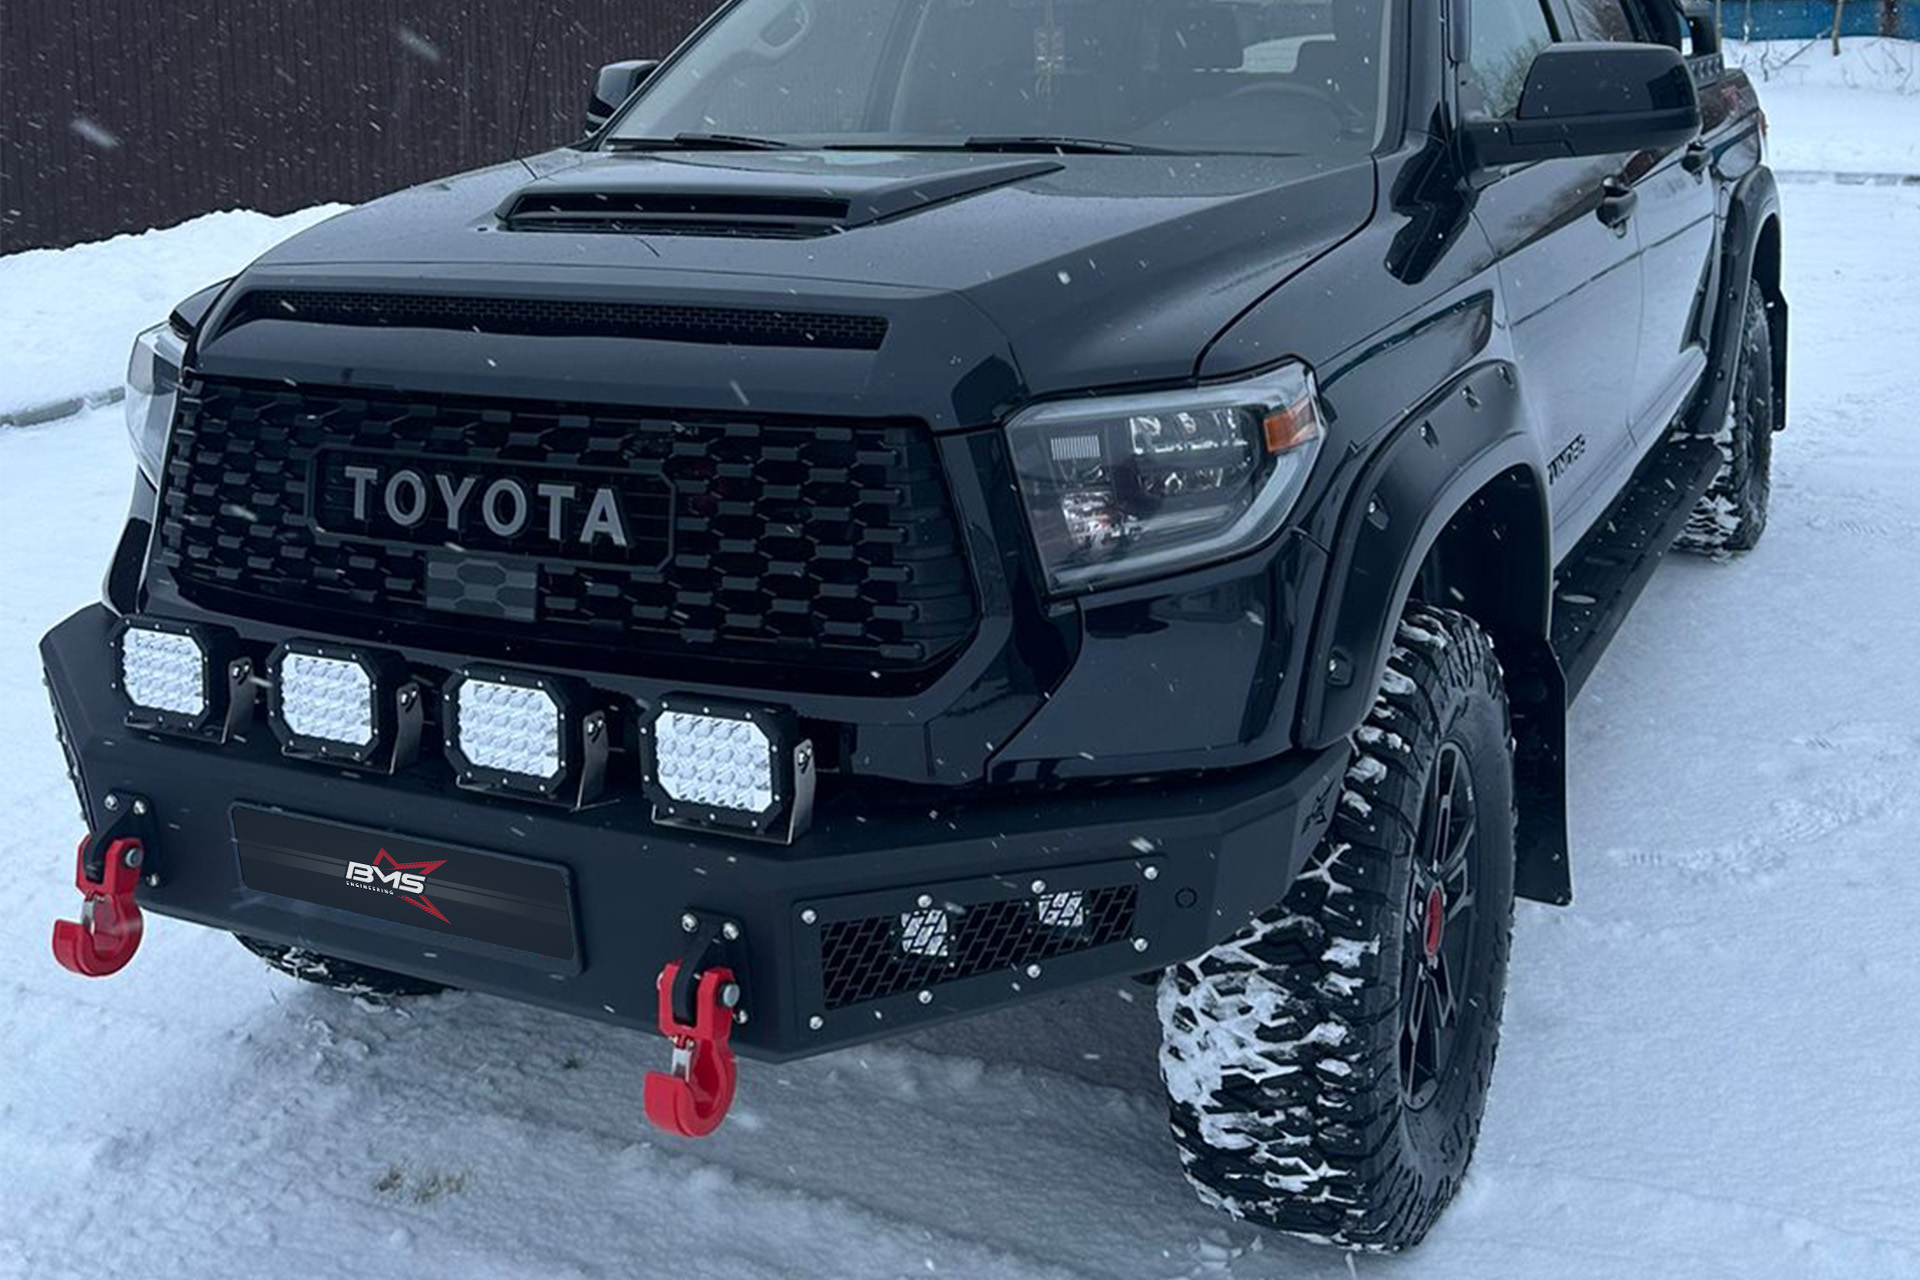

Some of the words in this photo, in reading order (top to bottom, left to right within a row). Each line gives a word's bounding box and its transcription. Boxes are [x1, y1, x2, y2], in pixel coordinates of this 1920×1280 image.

[345, 466, 627, 546] TOYOTA
[345, 861, 426, 894] BMS
[346, 880, 394, 895] ENGINEERING
